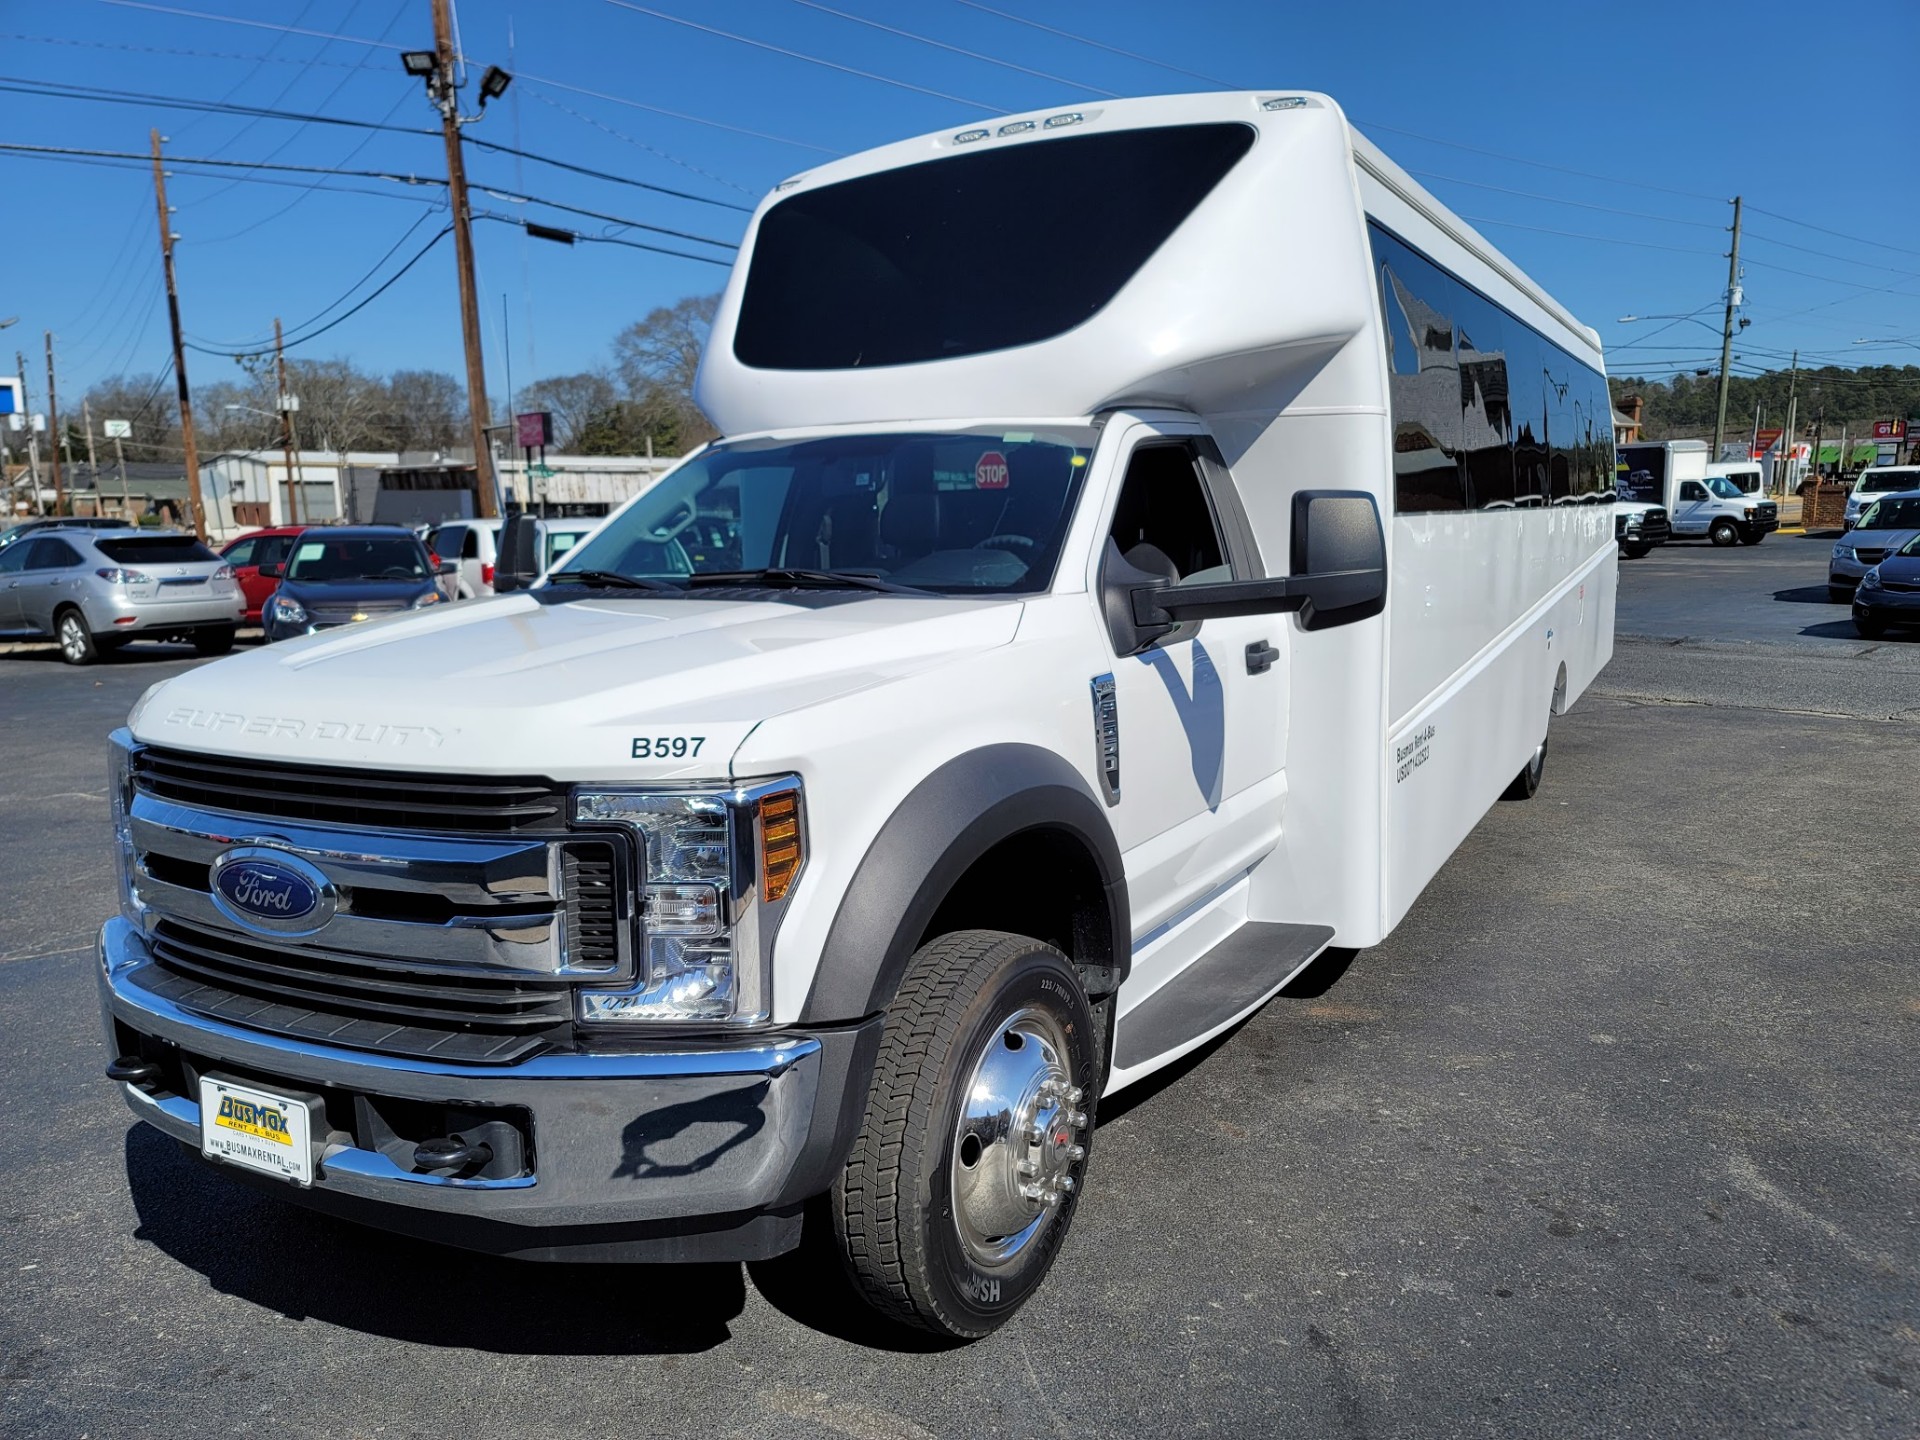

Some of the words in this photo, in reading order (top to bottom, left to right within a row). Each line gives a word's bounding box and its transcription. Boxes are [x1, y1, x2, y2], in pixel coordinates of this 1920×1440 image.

[978, 464, 1007, 483] STOP
[163, 707, 306, 739] SUPER
[309, 720, 459, 748] DUTY
[631, 736, 706, 758] B597
[234, 869, 293, 910] Ford
